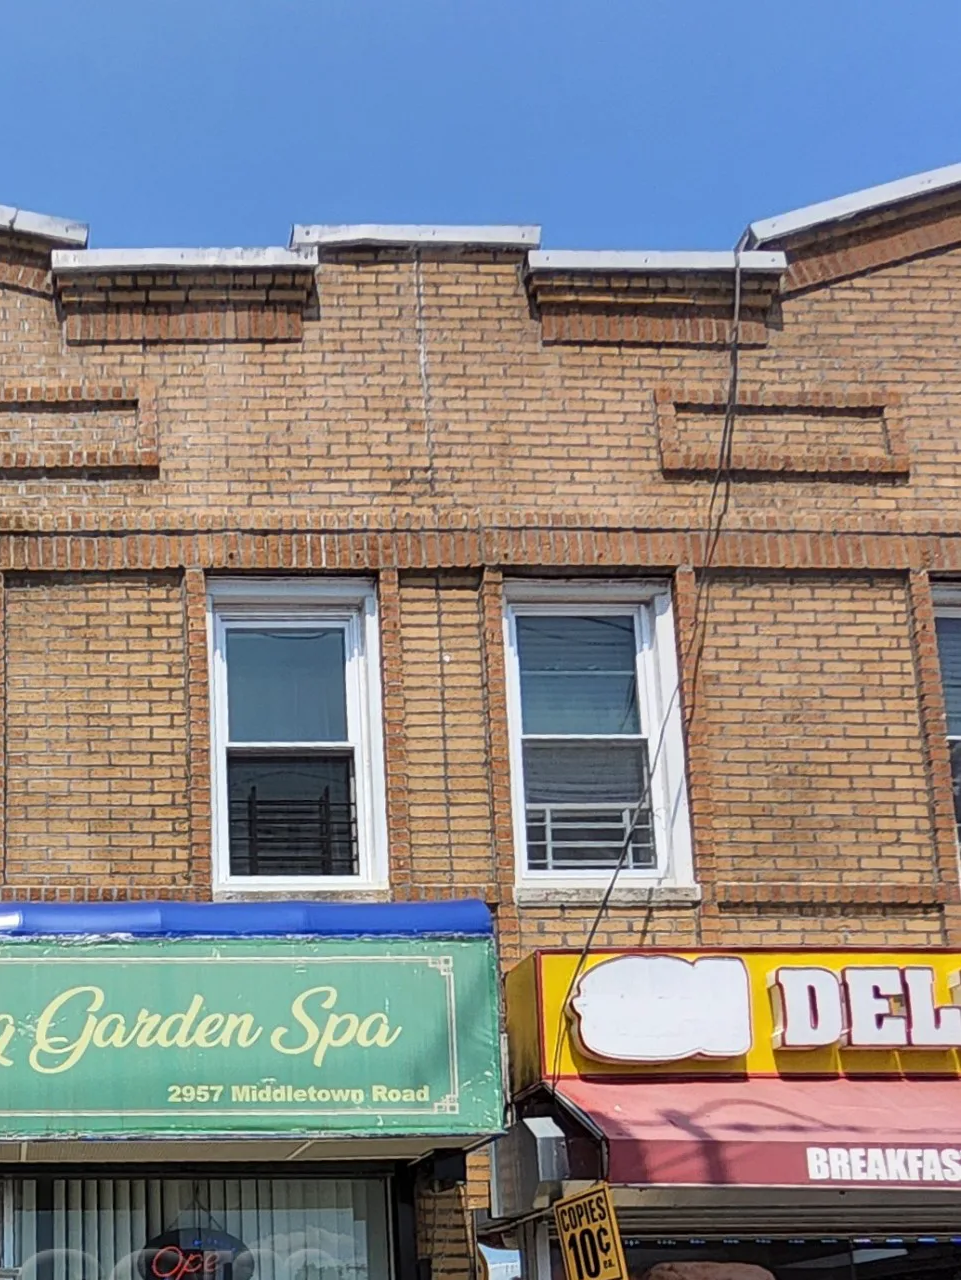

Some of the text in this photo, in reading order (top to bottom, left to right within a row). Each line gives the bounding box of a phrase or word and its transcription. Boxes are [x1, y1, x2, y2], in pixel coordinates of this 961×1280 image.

[775, 966, 961, 1049] DEL
[29, 985, 263, 1075] Garden
[271, 985, 402, 1068] Spa
[167, 1085, 430, 1104] 2957 Middletown Road
[805, 1146, 961, 1182] BREAKFAS
[560, 1195, 608, 1233] COPIES
